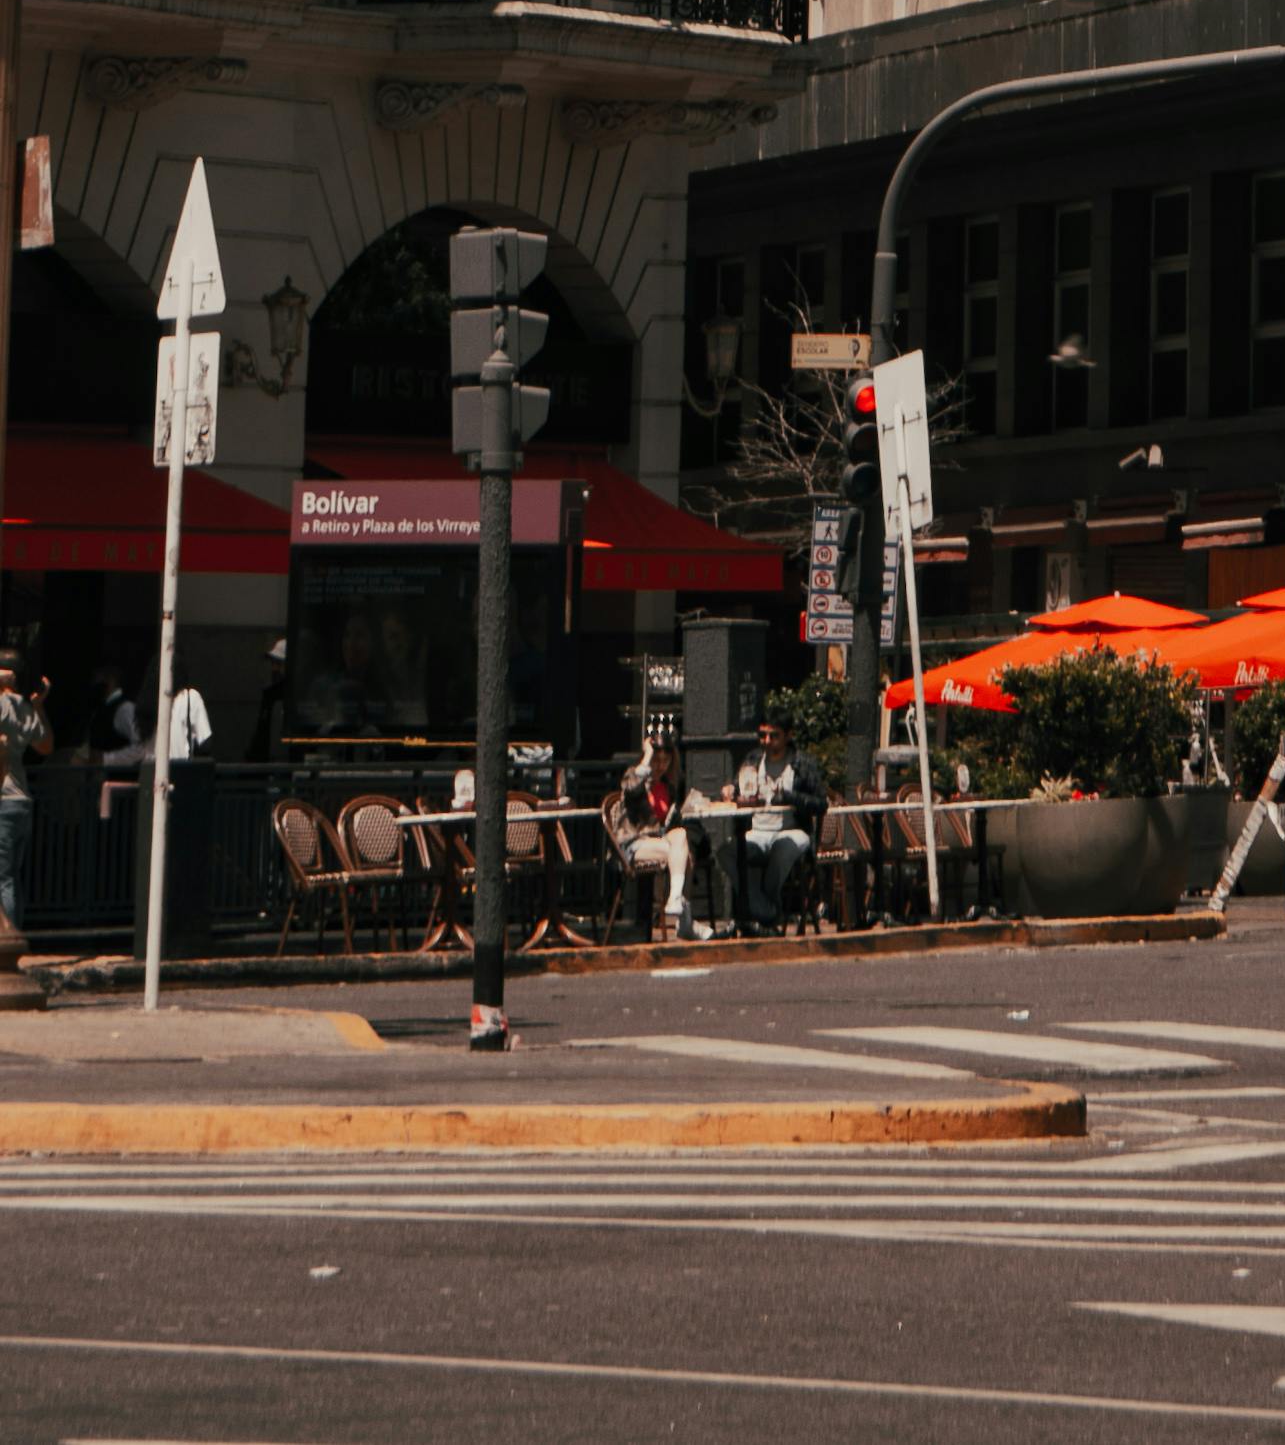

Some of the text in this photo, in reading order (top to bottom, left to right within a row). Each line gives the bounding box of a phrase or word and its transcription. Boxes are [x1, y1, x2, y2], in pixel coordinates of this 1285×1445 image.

[301, 491, 379, 515] Bolívar
[301, 518, 482, 536] a Retiro y Plaza de los Virreye
[104, 540, 159, 563] MAY
